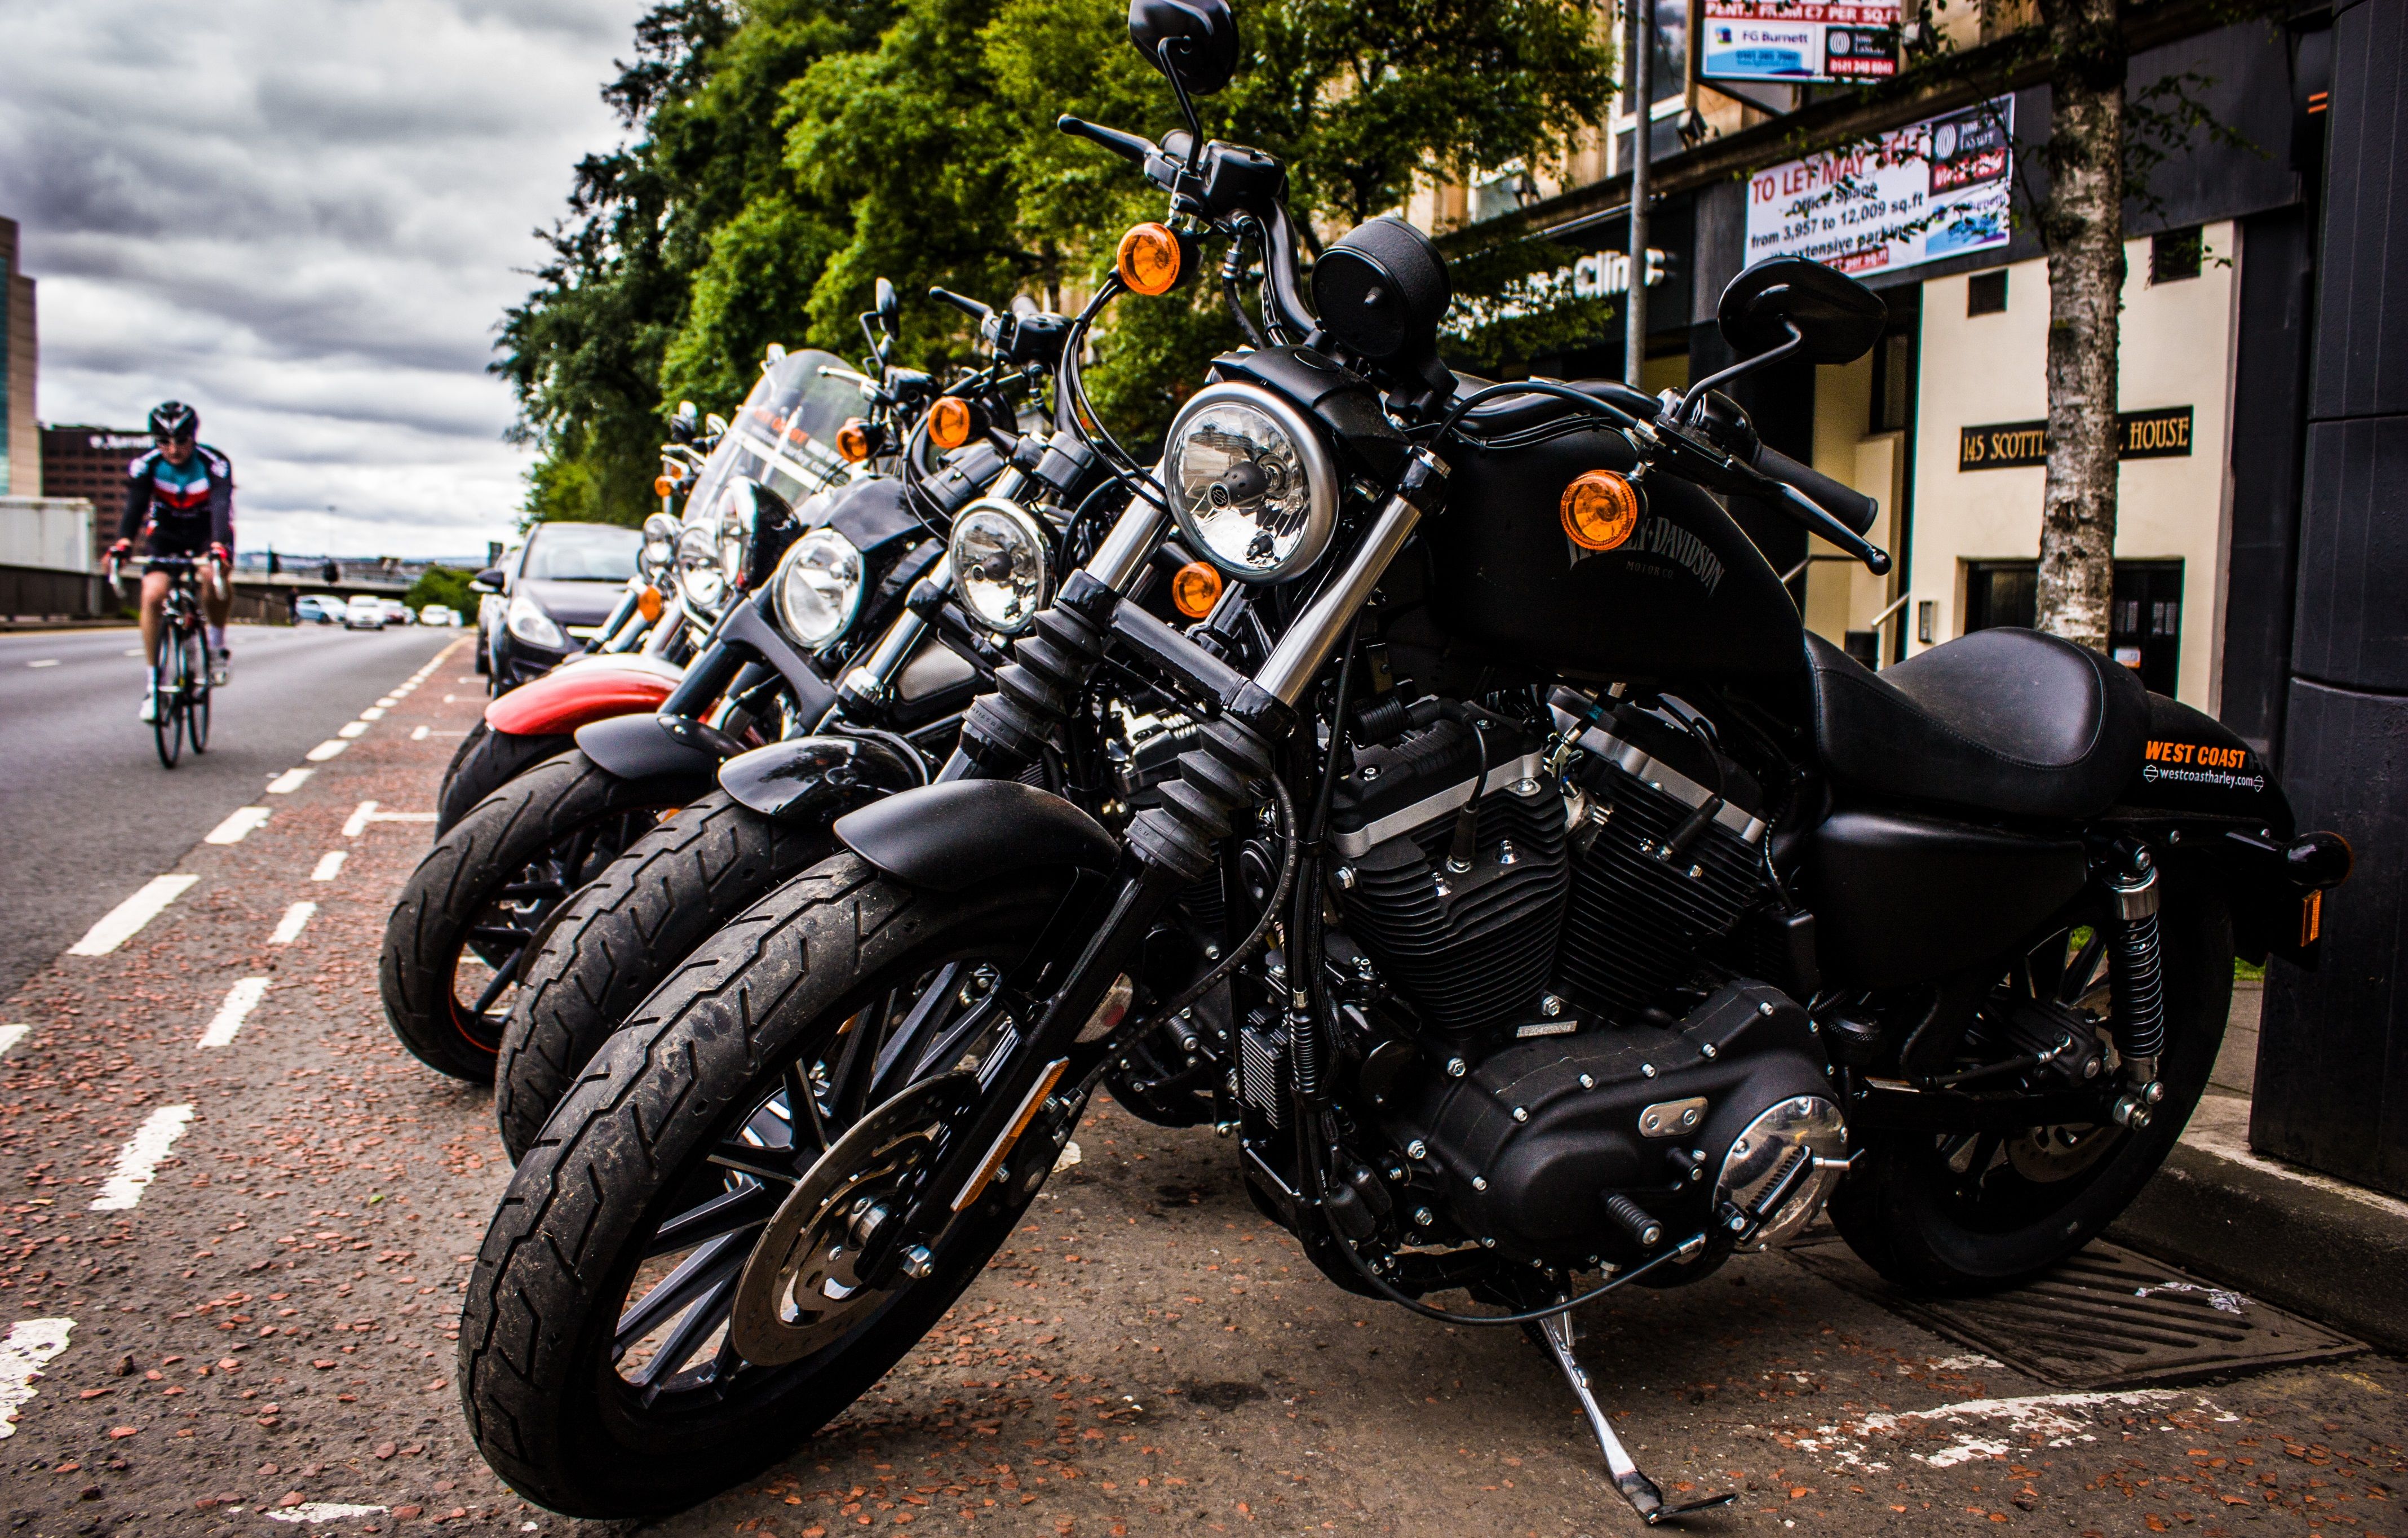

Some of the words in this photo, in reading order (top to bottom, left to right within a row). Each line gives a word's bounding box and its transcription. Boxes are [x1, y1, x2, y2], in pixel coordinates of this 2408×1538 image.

[1828, 7, 1857, 21] PER
[1743, 30, 1759, 42] FG
[1762, 30, 1808, 43] Burnett
[1753, 174, 1775, 204] TO
[1751, 231, 1779, 249] from
[1784, 218, 1818, 242] 3,957
[1823, 215, 1835, 230] to
[1841, 201, 1886, 226] 12,009
[1891, 192, 1923, 214] sq.ft
[1963, 434, 1985, 463] 145
[1990, 430, 2048, 461] SCOTTI
[2130, 416, 2189, 451] HOUSE
[1626, 560, 1660, 577] MOTOR
[2145, 741, 2195, 764] WEST
[2197, 746, 2246, 769] COAST
[2159, 768, 2254, 789] westcoastharley.com
